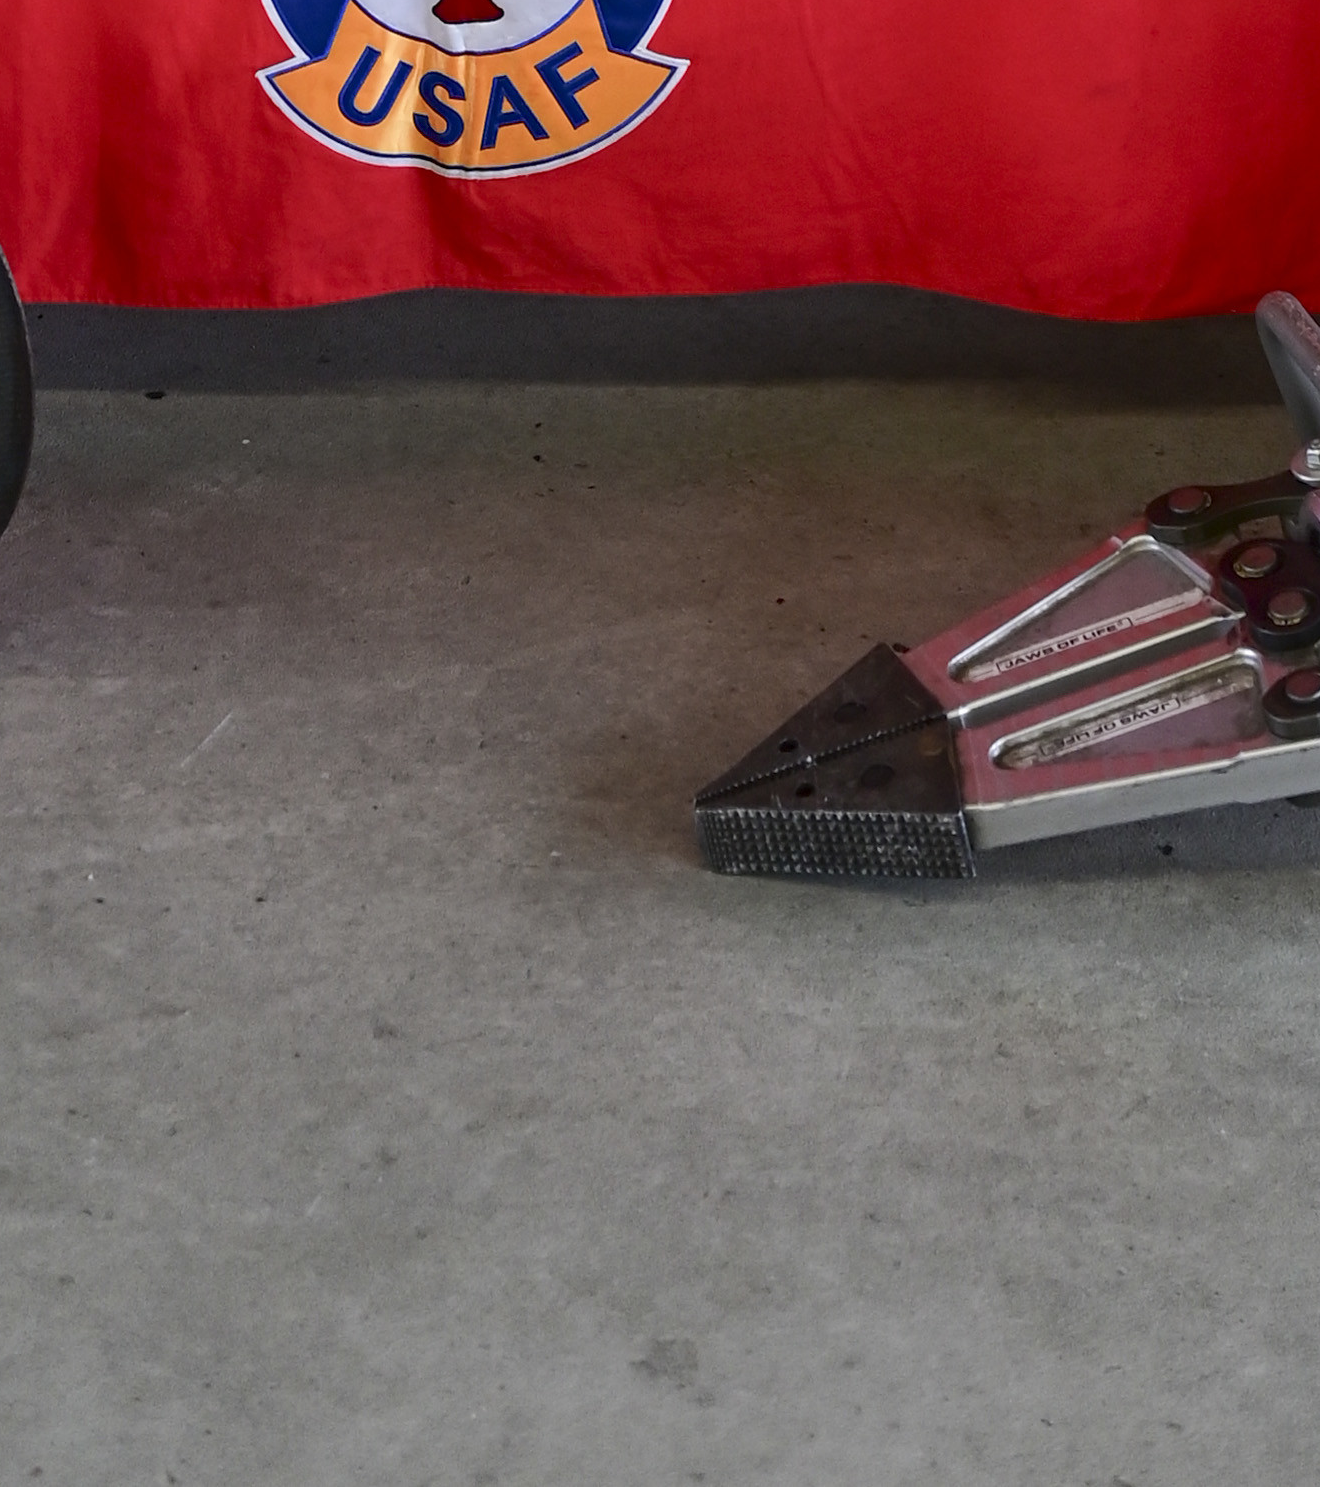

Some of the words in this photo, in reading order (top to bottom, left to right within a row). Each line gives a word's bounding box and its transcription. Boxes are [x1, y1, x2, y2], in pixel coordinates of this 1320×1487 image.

[336, 40, 605, 150] USAF
[1004, 645, 1055, 669] JAWS
[1057, 636, 1081, 650] OF
